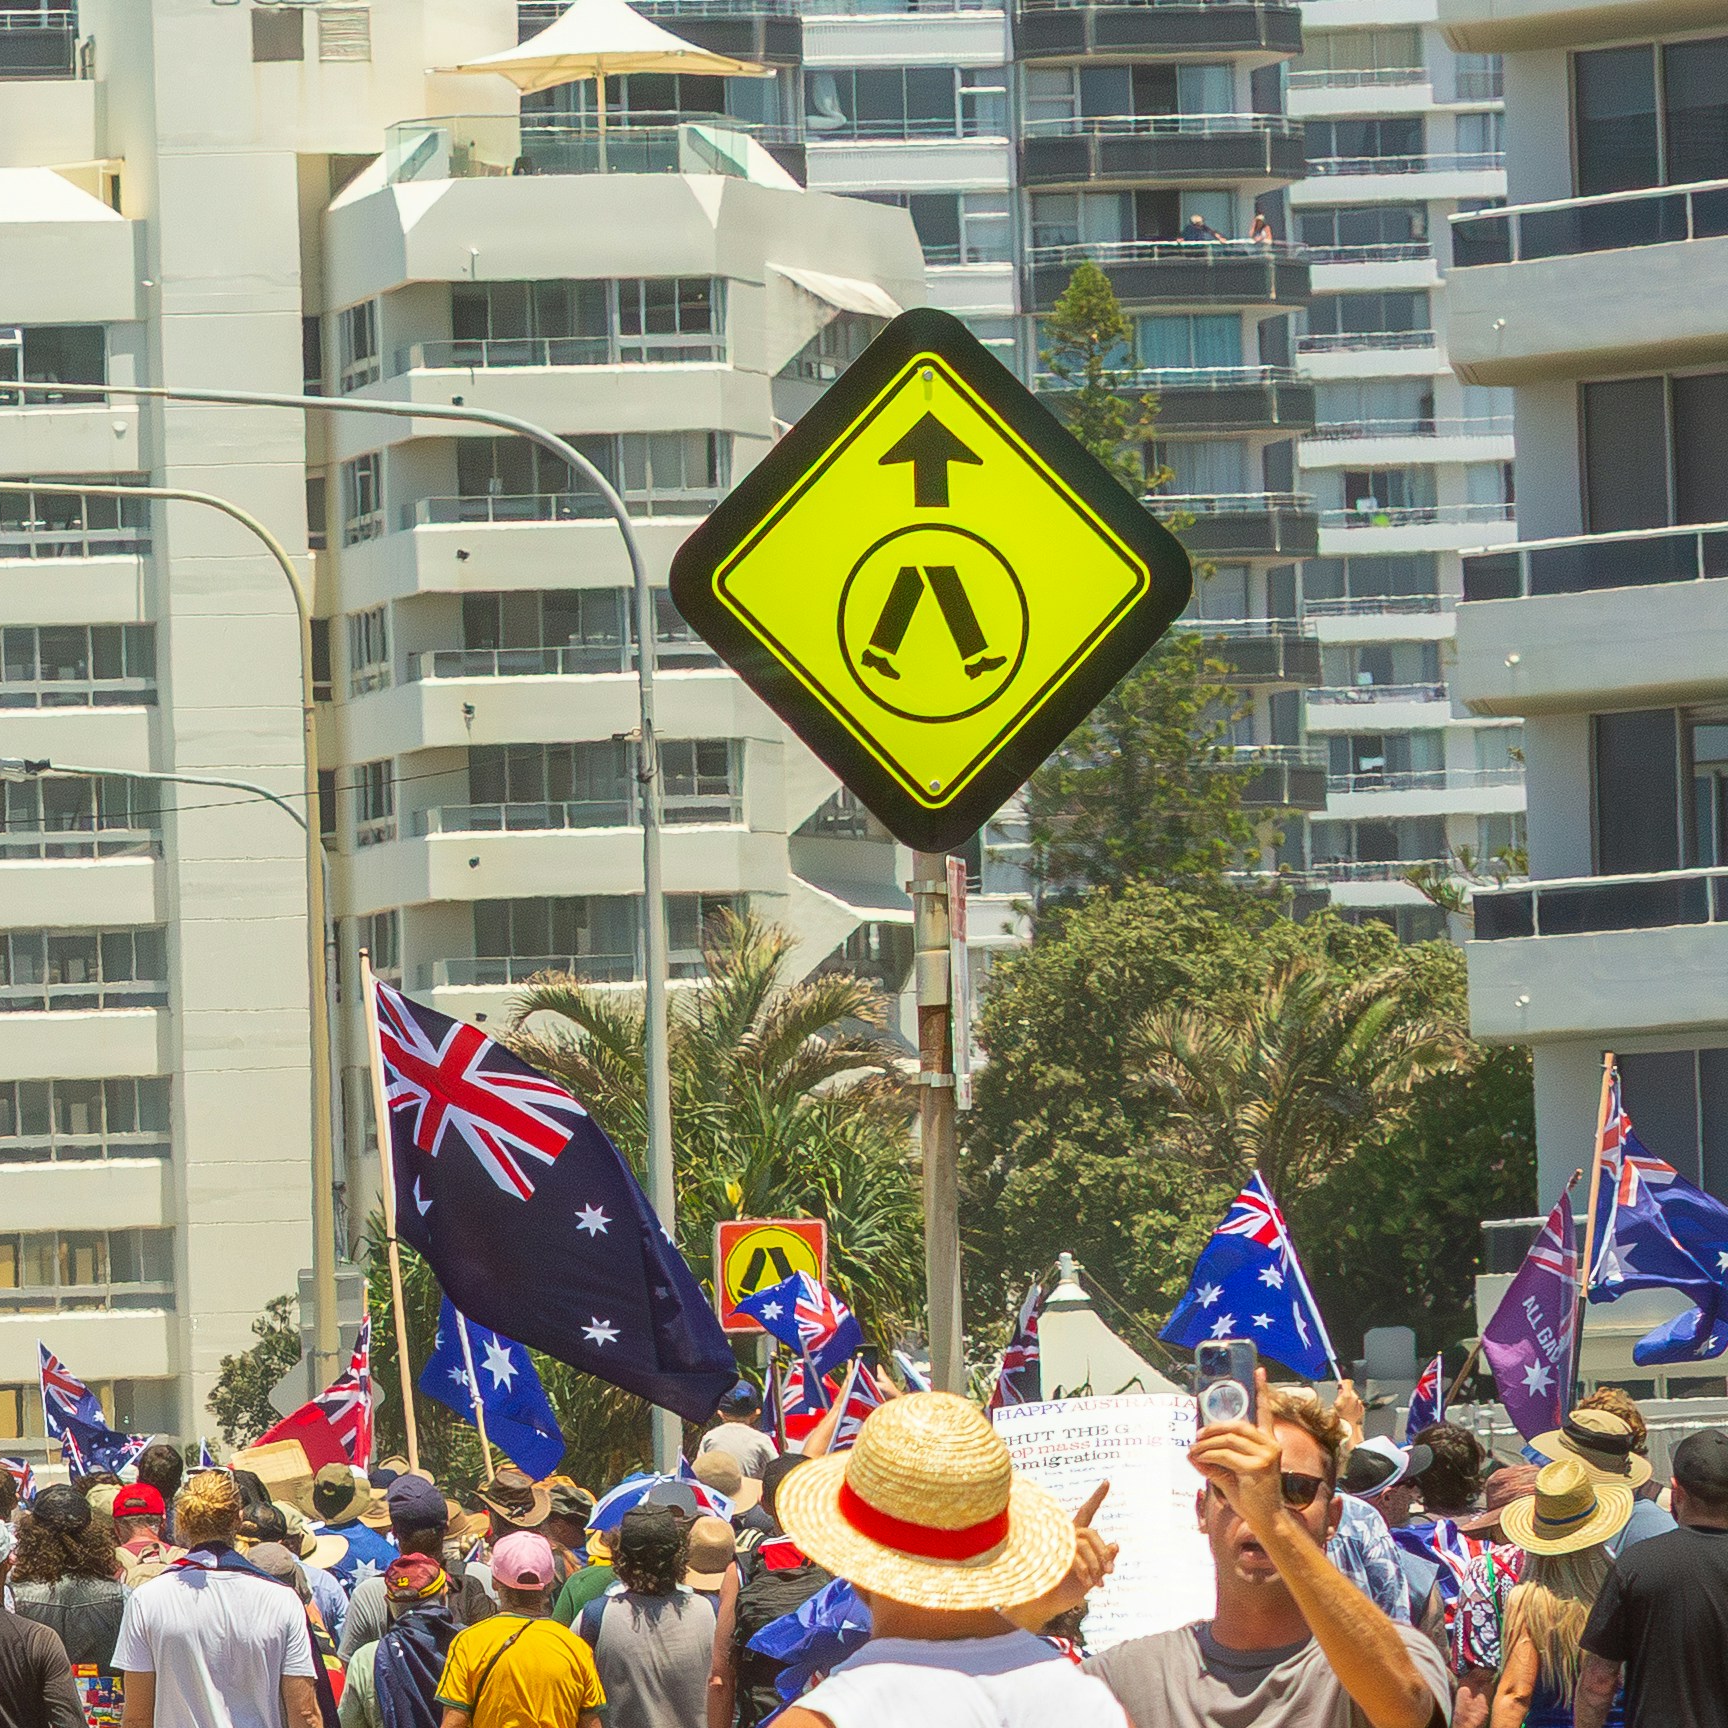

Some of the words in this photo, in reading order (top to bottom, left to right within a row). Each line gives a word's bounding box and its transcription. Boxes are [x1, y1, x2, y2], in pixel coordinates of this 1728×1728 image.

[1522, 1295, 1544, 1330] ALL
[997, 1402, 1067, 1421] HAPPY
[1072, 1396, 1198, 1412] AUSTRALIA
[1063, 1425, 1109, 1439] THE
[1038, 1440, 1091, 1454] mass
